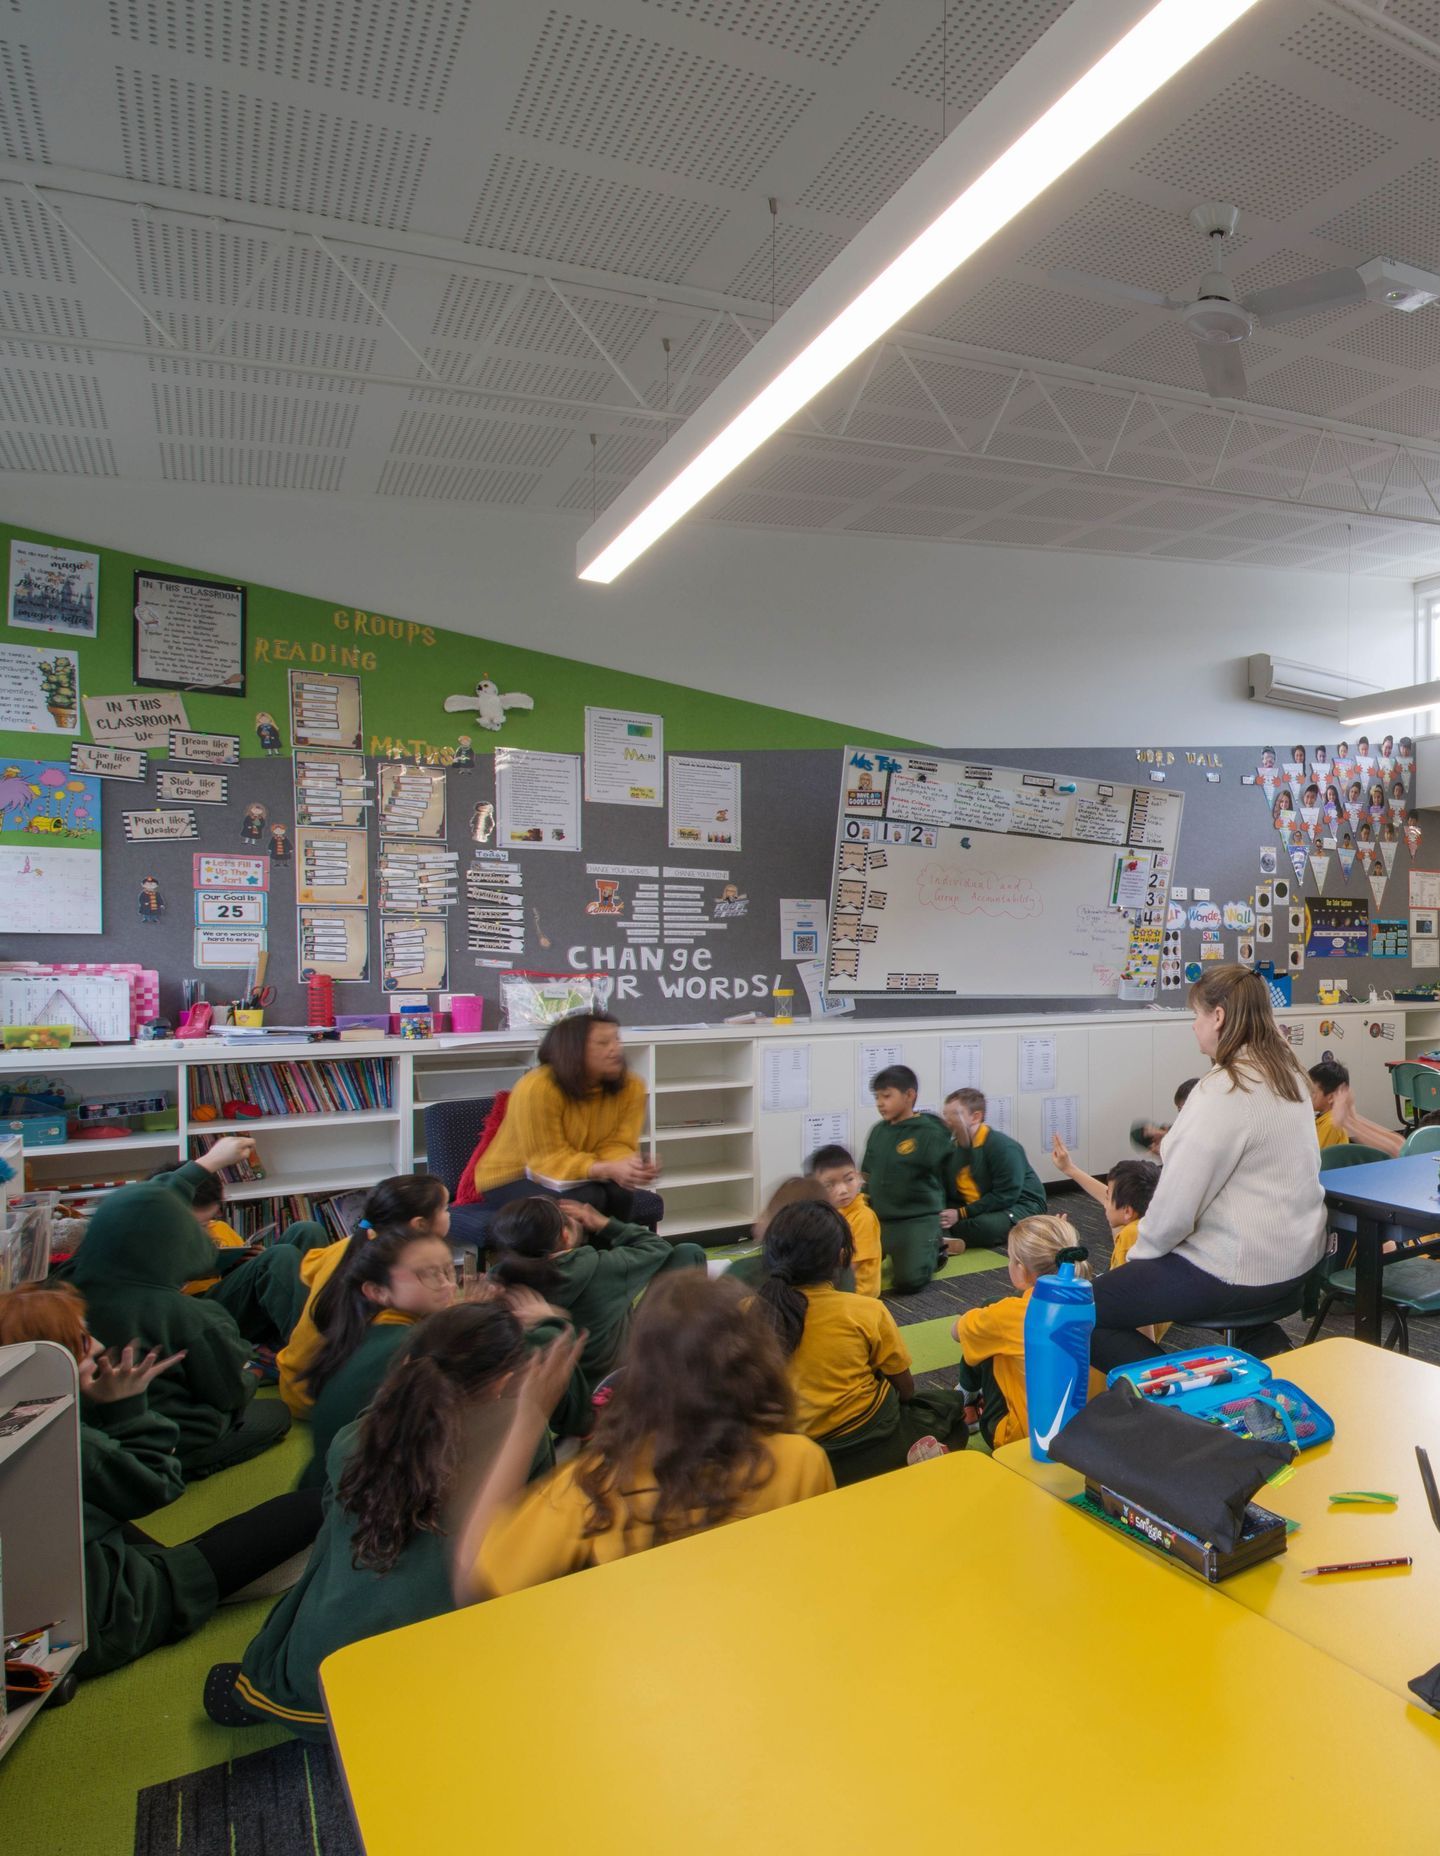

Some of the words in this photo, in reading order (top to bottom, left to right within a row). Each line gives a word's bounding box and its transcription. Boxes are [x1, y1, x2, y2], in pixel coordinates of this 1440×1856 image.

[142, 579, 153, 589] IN
[157, 581, 179, 592] THIS
[184, 587, 240, 601] CLASSROOM
[333, 610, 437, 647] GROUPS
[254, 637, 377, 672] READING
[105, 701, 122, 714] IN
[126, 698, 162, 711] THIS
[96, 714, 181, 730] CLASSROOM
[134, 731, 153, 742] We
[181, 736, 209, 747] Dream
[212, 739, 229, 749] like
[88, 750, 109, 760] Live
[114, 753, 131, 763] like
[184, 747, 225, 760] Lovegood
[370, 735, 455, 767] MATHS
[95, 759, 122, 770] Potter
[1135, 749, 1175, 768] WORD
[1185, 751, 1223, 768] WALL
[170, 776, 194, 788] Study
[199, 778, 216, 788] like
[175, 787, 210, 798] Granger
[134, 816, 164, 826] Protect
[169, 816, 186, 825] like
[143, 826, 179, 835] Weasley
[847, 821, 860, 838] 0
[911, 826, 924, 843] 2
[477, 851, 507, 861] Today
[1153, 854, 1158, 869] 1
[237, 860, 252, 868] Fill
[612, 866, 627, 874] YOUR
[215, 868, 229, 876] Up
[231, 868, 248, 876] The
[673, 869, 697, 878] CHANGE
[1148, 873, 1158, 888] 2
[223, 893, 246, 901] Goal
[1146, 892, 1155, 906] 3
[217, 905, 244, 918] 25
[1143, 911, 1153, 925] 4
[1227, 907, 1251, 924] Wall
[1203, 932, 1219, 941] SUN
[1135, 1514, 1163, 1542] smiggle
